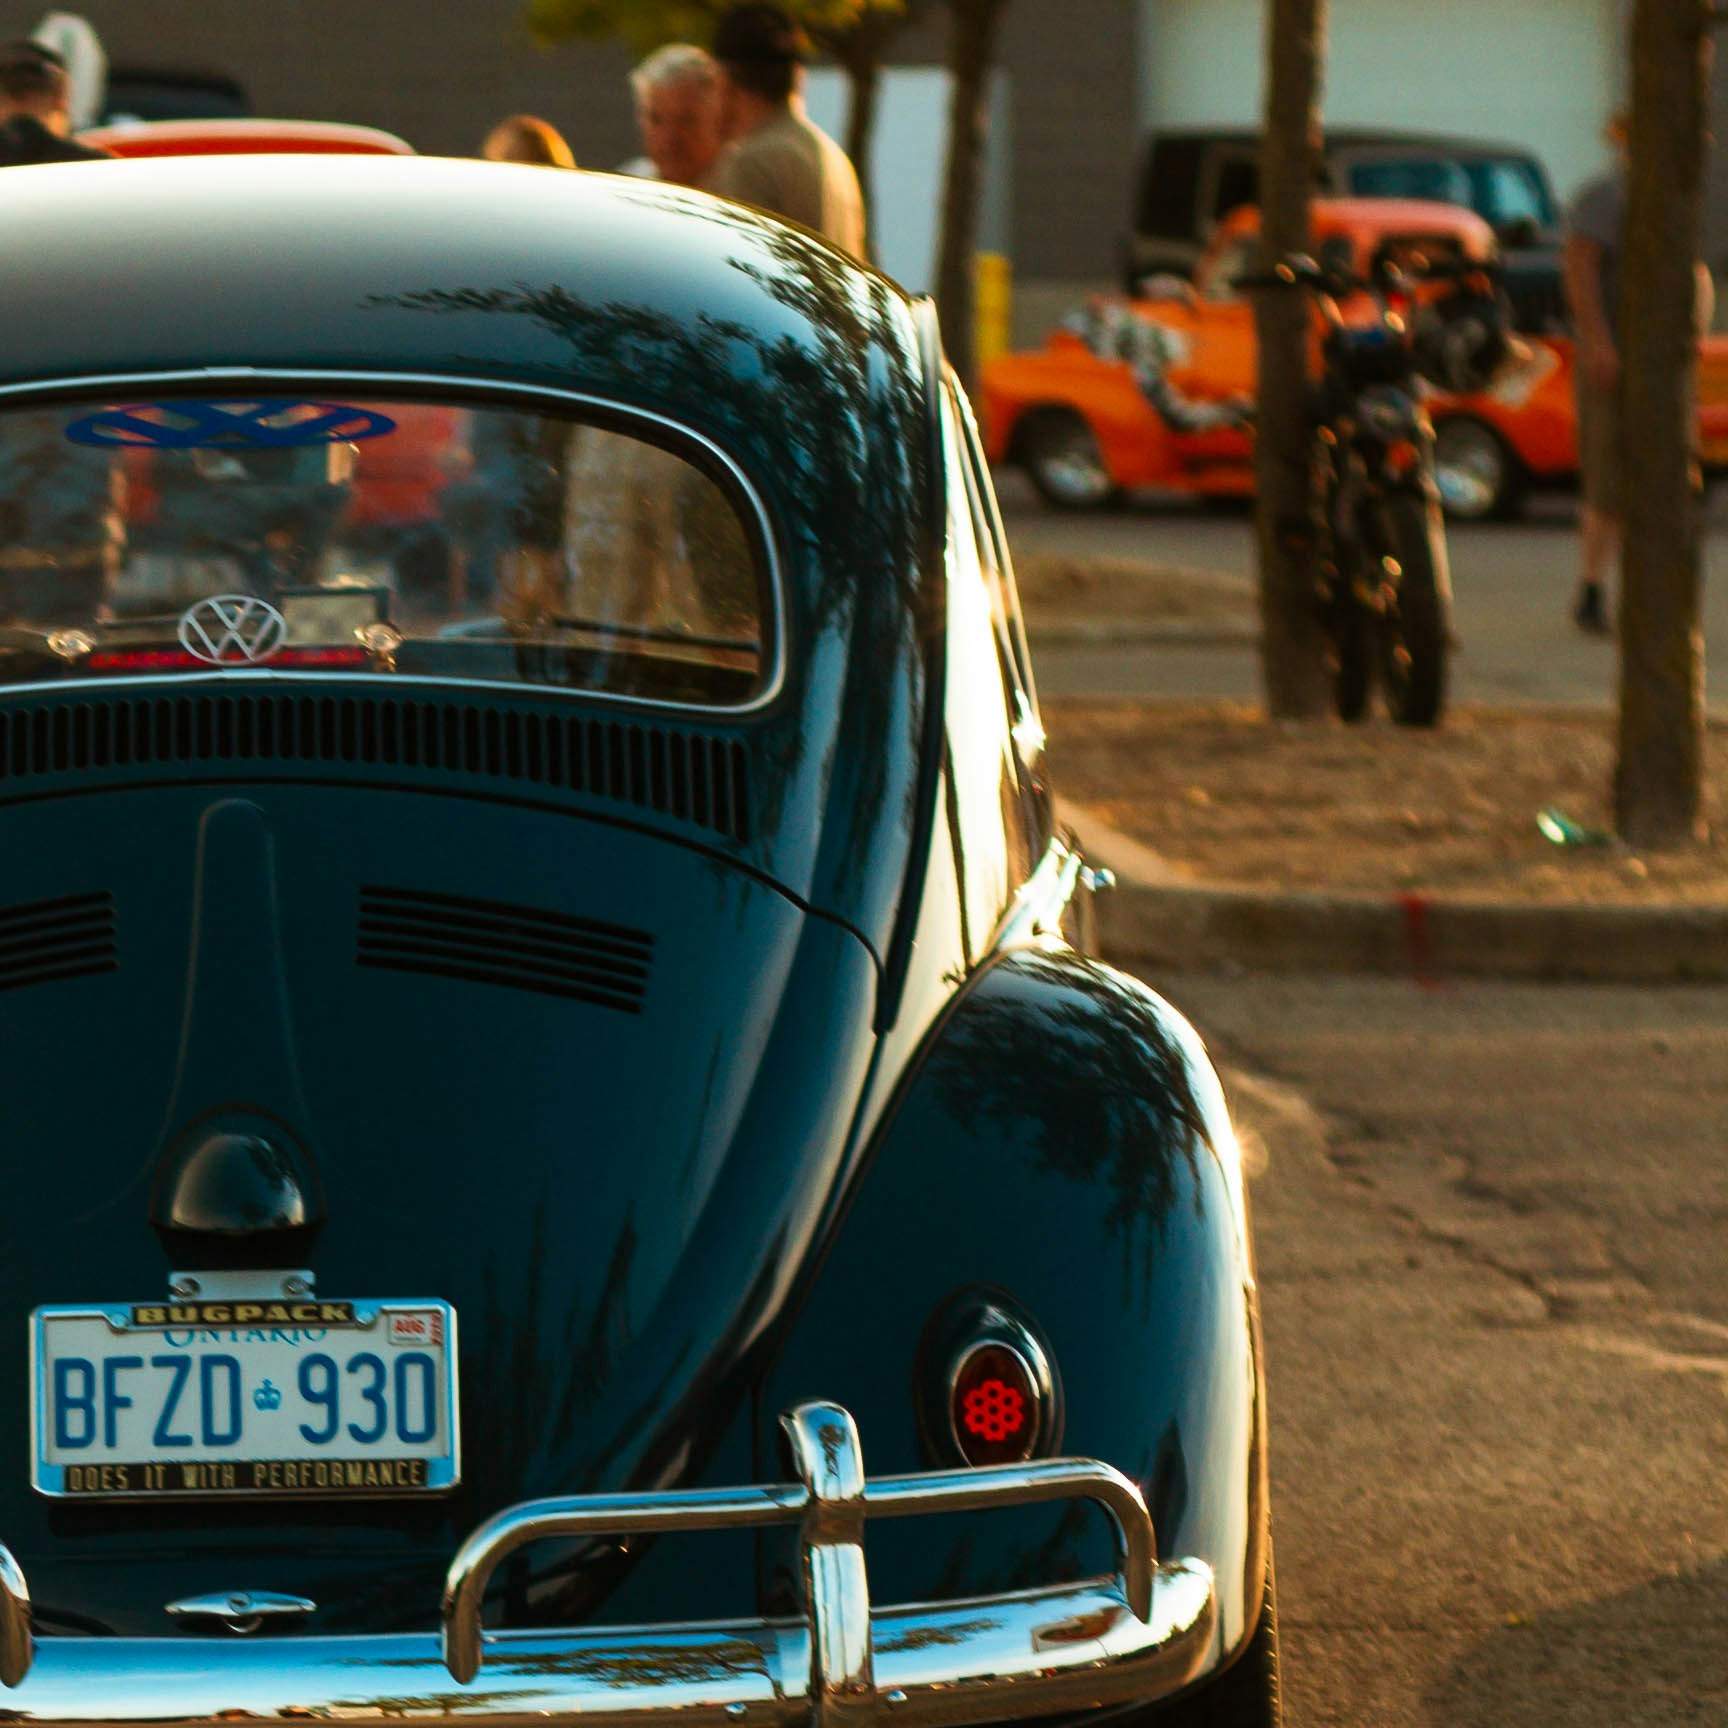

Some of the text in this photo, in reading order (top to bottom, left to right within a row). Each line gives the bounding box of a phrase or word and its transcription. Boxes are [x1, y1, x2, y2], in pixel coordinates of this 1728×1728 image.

[178, 594, 287, 666] VW
[137, 1304, 349, 1323] BUGPACK
[55, 1351, 438, 1447] BFZD 930
[68, 1460, 424, 1491] DOES IT WITH PERFORMANCE
